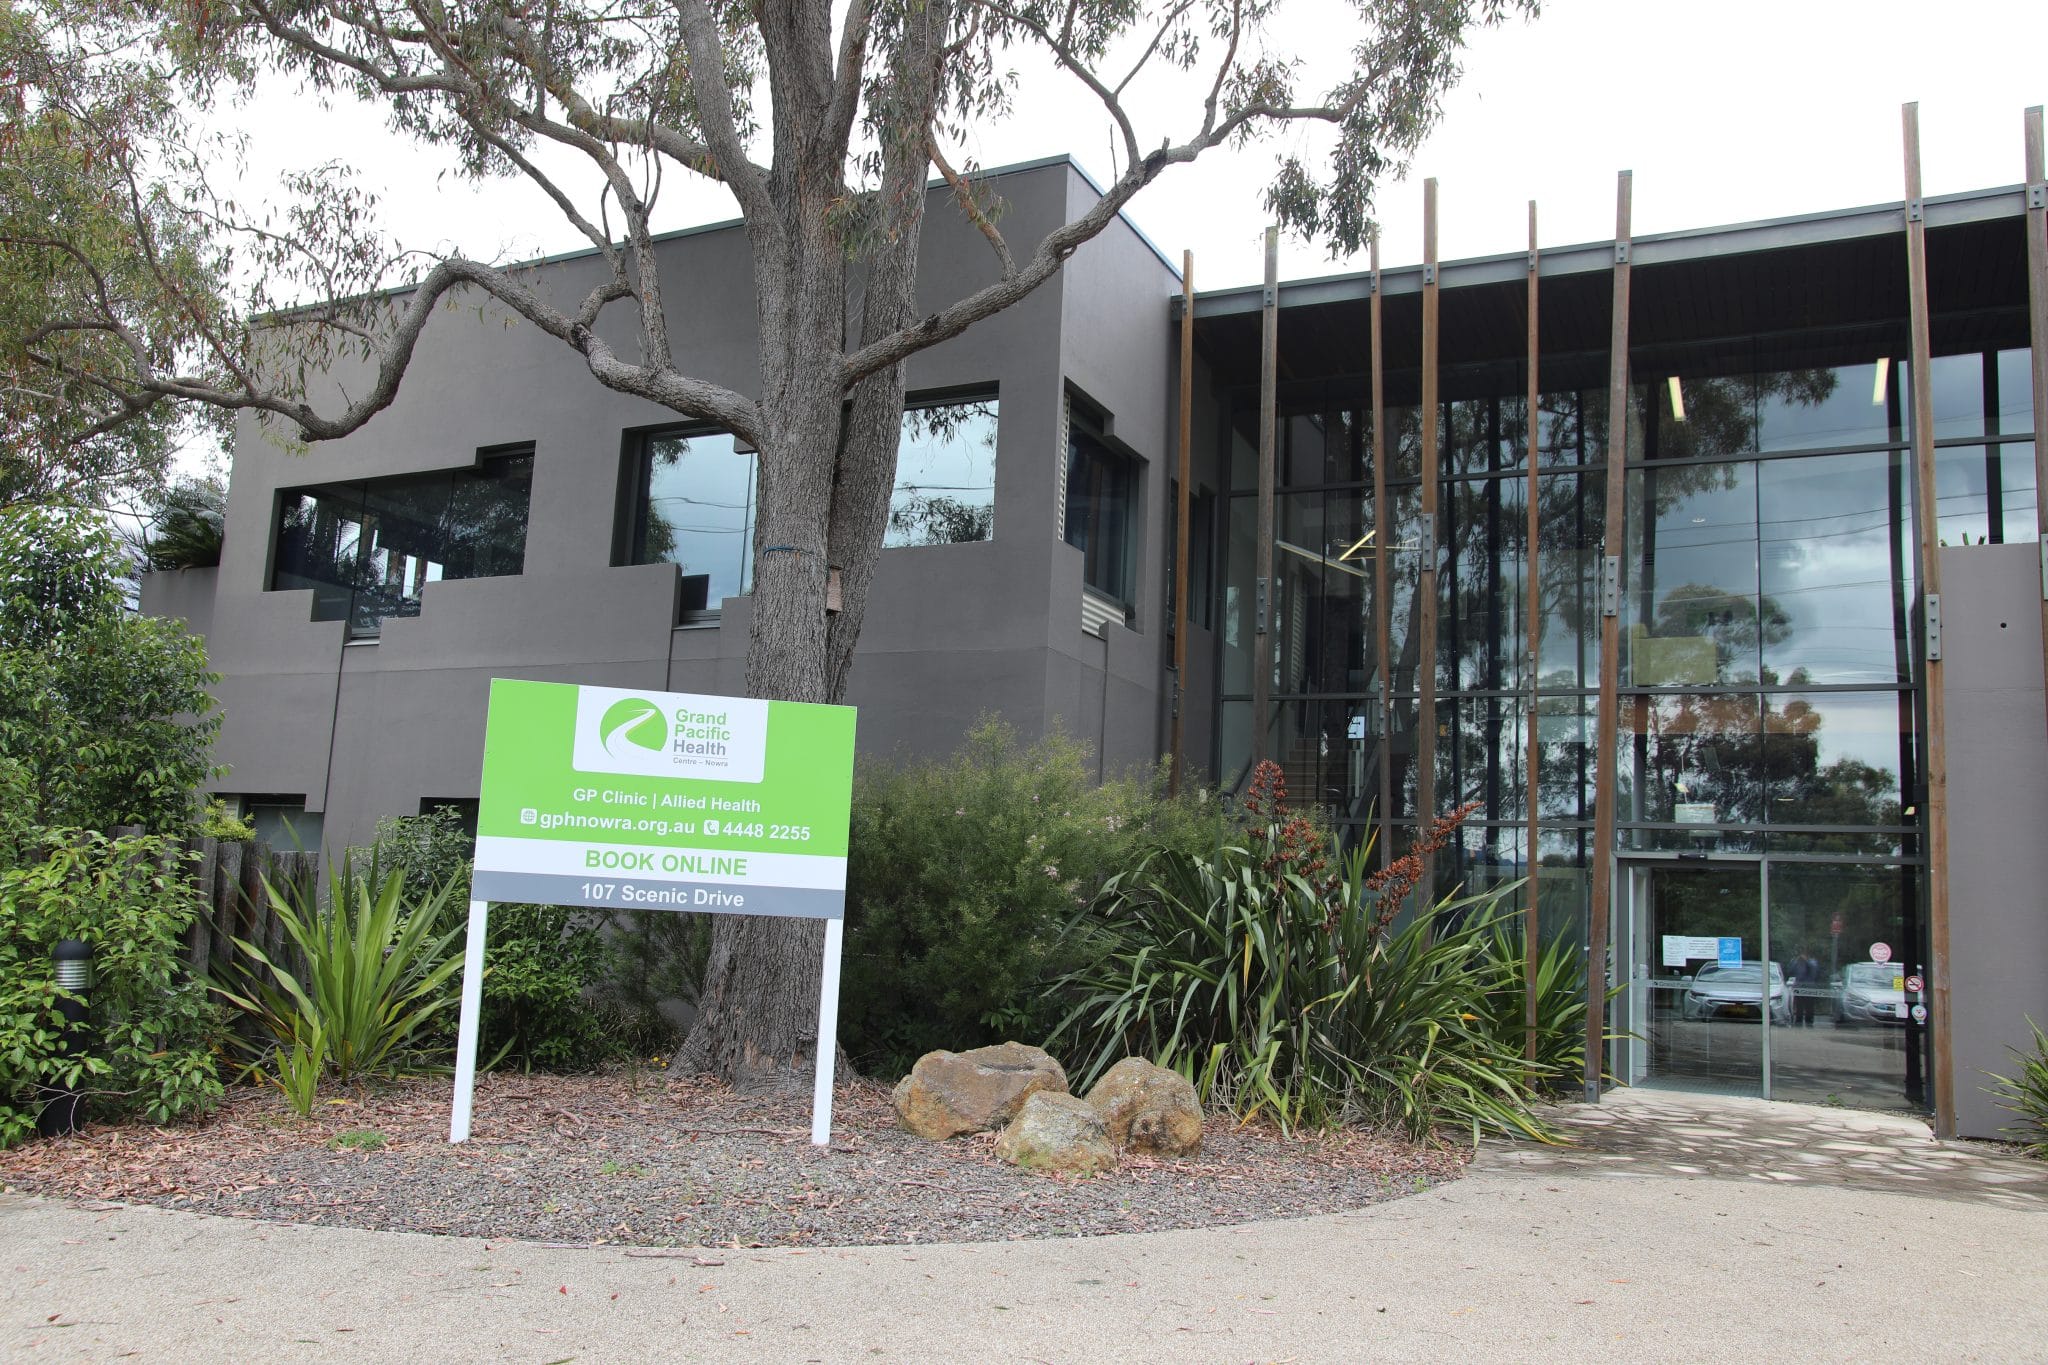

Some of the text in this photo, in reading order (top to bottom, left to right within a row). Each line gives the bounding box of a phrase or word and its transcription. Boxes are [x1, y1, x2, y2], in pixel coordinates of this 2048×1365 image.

[675, 708, 727, 725] Grand
[674, 724, 731, 741] Pacific
[673, 739, 726, 755] Health
[673, 757, 697, 765] Centre
[705, 759, 729, 767] Nowra
[573, 788, 598, 802] GP
[602, 790, 648, 806] Clinic
[661, 794, 706, 809] Allied
[711, 797, 761, 813] Health
[540, 811, 811, 841] gphnowra.org.au 4448 2255
[585, 849, 748, 876] BOOK ONLINE
[582, 882, 745, 907] 107 Scenic Drive
